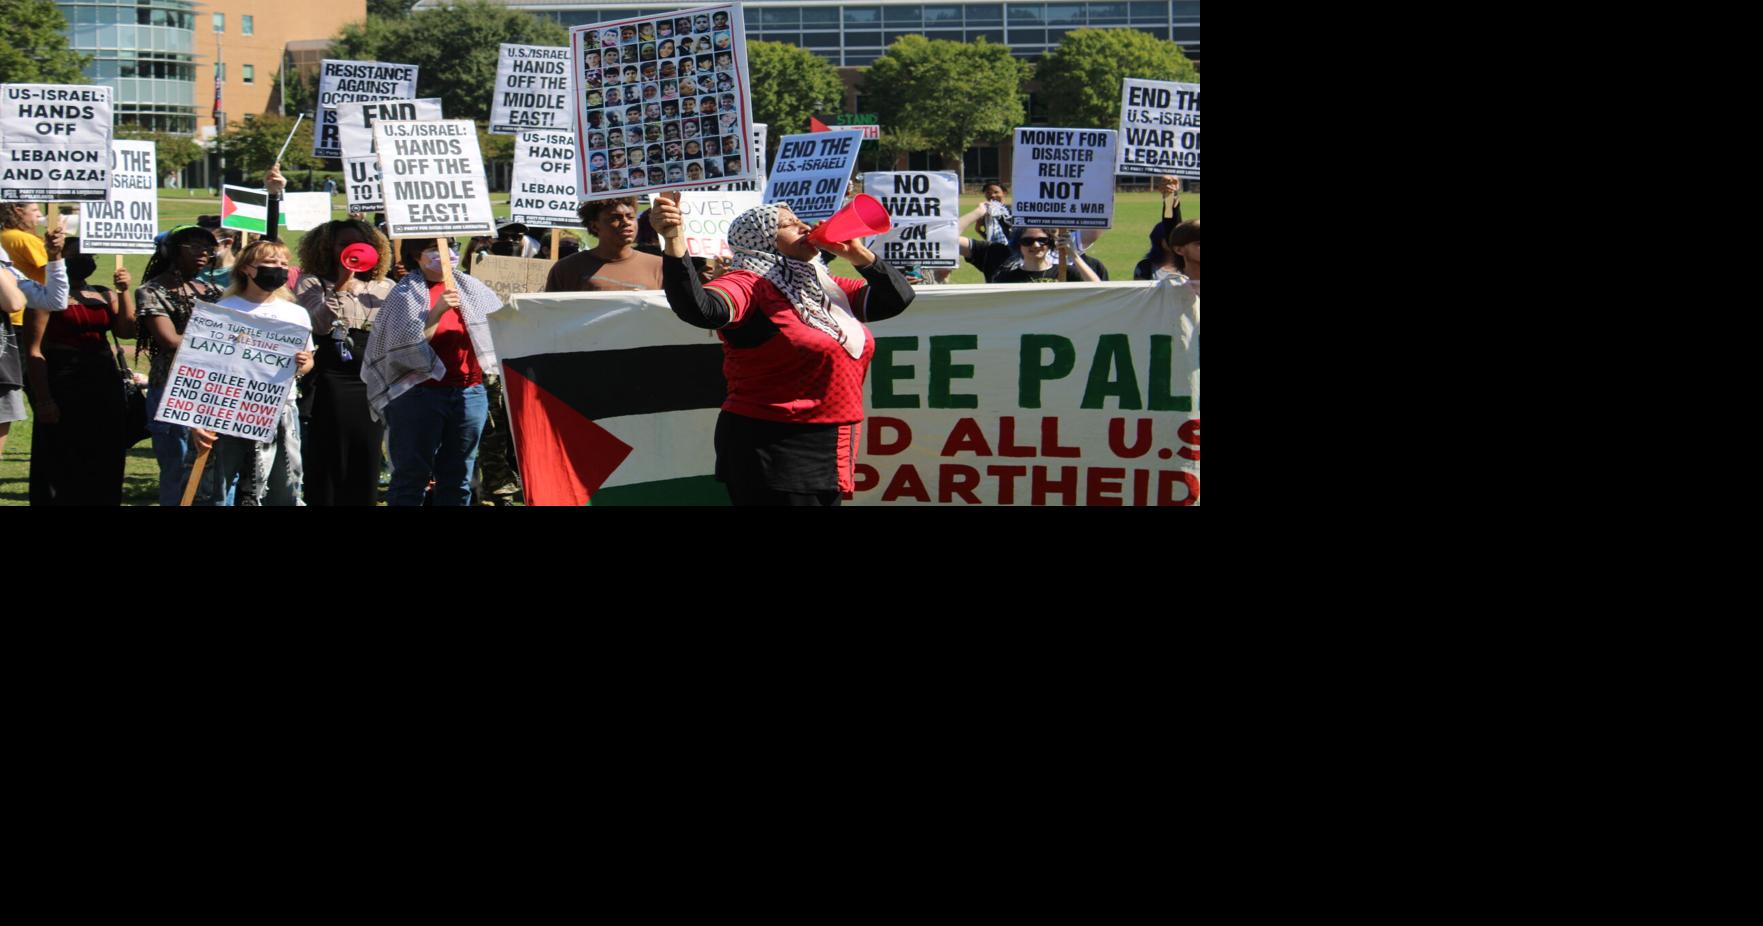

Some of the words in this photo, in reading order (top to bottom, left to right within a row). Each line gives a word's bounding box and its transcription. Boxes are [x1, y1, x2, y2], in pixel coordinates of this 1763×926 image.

[325, 63, 412, 81] RESISTANCE
[513, 60, 564, 74] HANDS
[337, 79, 398, 95] AGAINST
[507, 75, 536, 88] OFF
[540, 76, 567, 90] THE
[9, 88, 105, 102] US-ISRAEL:
[503, 92, 565, 109] MIDDLE
[1128, 86, 1170, 109] END
[19, 104, 95, 120] HANDS
[509, 110, 555, 126] EAST!
[36, 122, 76, 136] OFF
[384, 124, 467, 137] U.S./ISRAEL:
[1126, 127, 1174, 148] WAR
[395, 139, 462, 155] HANDS
[1021, 130, 1074, 146] MONEY
[1079, 132, 1107, 147] FOR
[12, 149, 98, 162] LEBANON
[529, 146, 574, 160] HAND
[781, 140, 816, 159] END
[821, 137, 853, 156] THE
[1032, 147, 1093, 162] DISASTER
[121, 150, 151, 172] THE
[393, 159, 429, 175] OFF
[433, 158, 472, 174] THE
[541, 162, 571, 173] OFF
[3, 168, 43, 180] AND
[49, 169, 105, 181] GAZA!
[1039, 163, 1085, 178] RELIEF
[352, 185, 372, 200] TO
[393, 181, 476, 200] MIDDLE
[522, 183, 575, 195] LEBANO
[772, 180, 811, 198] WAR
[815, 178, 841, 194] ON
[894, 175, 929, 195] NO
[1039, 181, 1083, 200] NOT
[86, 201, 124, 219] WAR
[130, 201, 152, 220] ON
[514, 198, 545, 209] AND
[681, 200, 735, 215] OVER
[881, 197, 941, 217] WAR
[1017, 201, 1069, 213] GENOCIDE
[1070, 204, 1076, 213] &
[1080, 202, 1104, 213] WAR
[408, 203, 469, 223] EAST!
[86, 222, 153, 240] LEBANON
[900, 224, 928, 240] ON
[884, 242, 940, 259] IRAN!
[194, 316, 223, 329] FROM
[228, 323, 262, 337] TURTLE
[265, 331, 302, 345] ISLAND
[210, 330, 224, 340] TO
[190, 337, 235, 356] LAND
[242, 348, 291, 369] BACK!
[178, 365, 205, 379] END
[208, 372, 246, 388] GILEE
[248, 380, 285, 396] NOW!
[174, 376, 202, 389] END
[204, 382, 242, 398] GILEE
[244, 391, 281, 406] NOW!
[170, 387, 198, 400] END
[200, 393, 238, 409] GILEE
[240, 401, 277, 417] NOW!
[166, 397, 194, 411] END
[197, 404, 234, 419] GILEE
[236, 412, 273, 427] NOW!
[163, 408, 190, 422] END
[193, 414, 231, 430] GILEE
[232, 422, 270, 438] NOW!
[940, 416, 1081, 458] ALL
